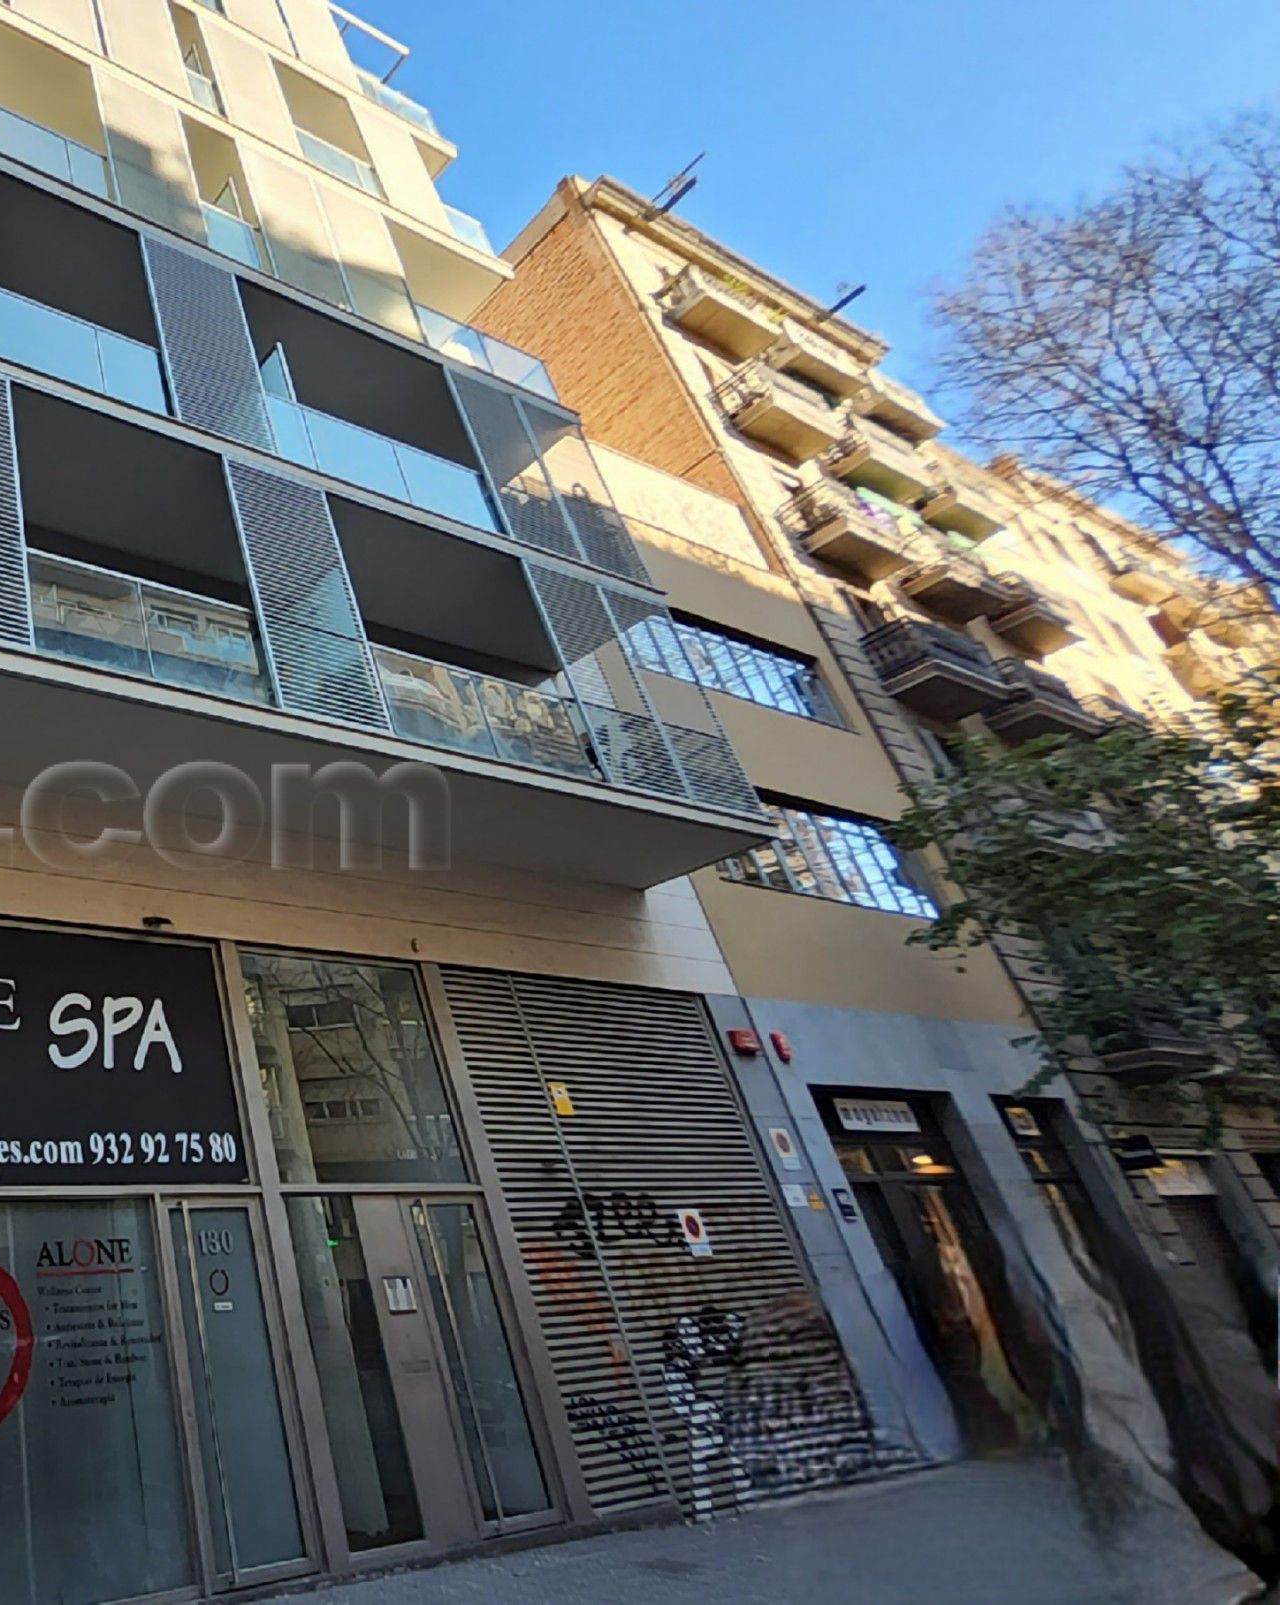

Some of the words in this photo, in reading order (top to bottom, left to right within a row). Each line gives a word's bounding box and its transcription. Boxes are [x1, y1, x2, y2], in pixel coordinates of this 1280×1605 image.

[47, 992, 183, 1074] SPA
[89, 1132, 134, 1165] 932
[140, 1132, 169, 1164] 92
[175, 1132, 204, 1163] 75
[209, 1132, 237, 1163] 80
[36, 1238, 133, 1268] ALONE
[198, 1229, 234, 1256] 130
